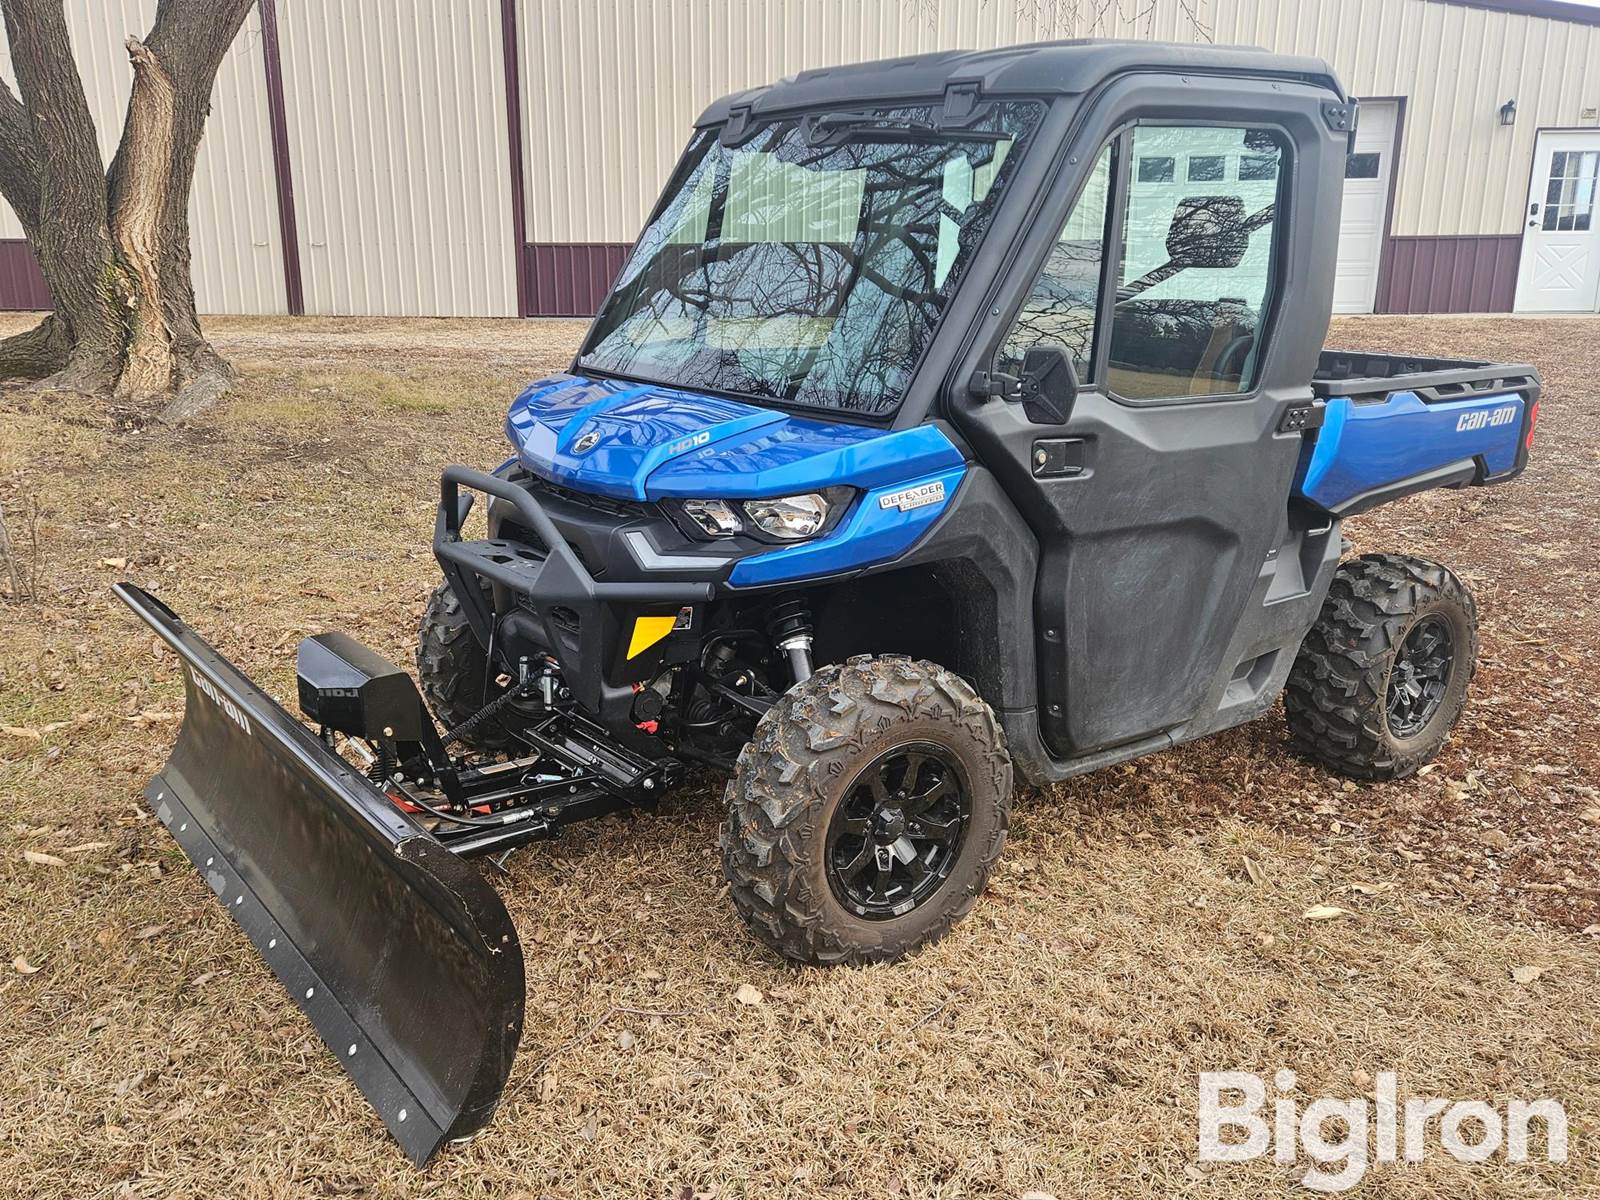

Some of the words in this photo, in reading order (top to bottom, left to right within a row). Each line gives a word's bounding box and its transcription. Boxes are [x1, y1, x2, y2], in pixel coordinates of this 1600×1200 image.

[1456, 406, 1517, 432] can-am
[668, 431, 710, 454] HD10
[882, 483, 944, 506] DEFENDER
